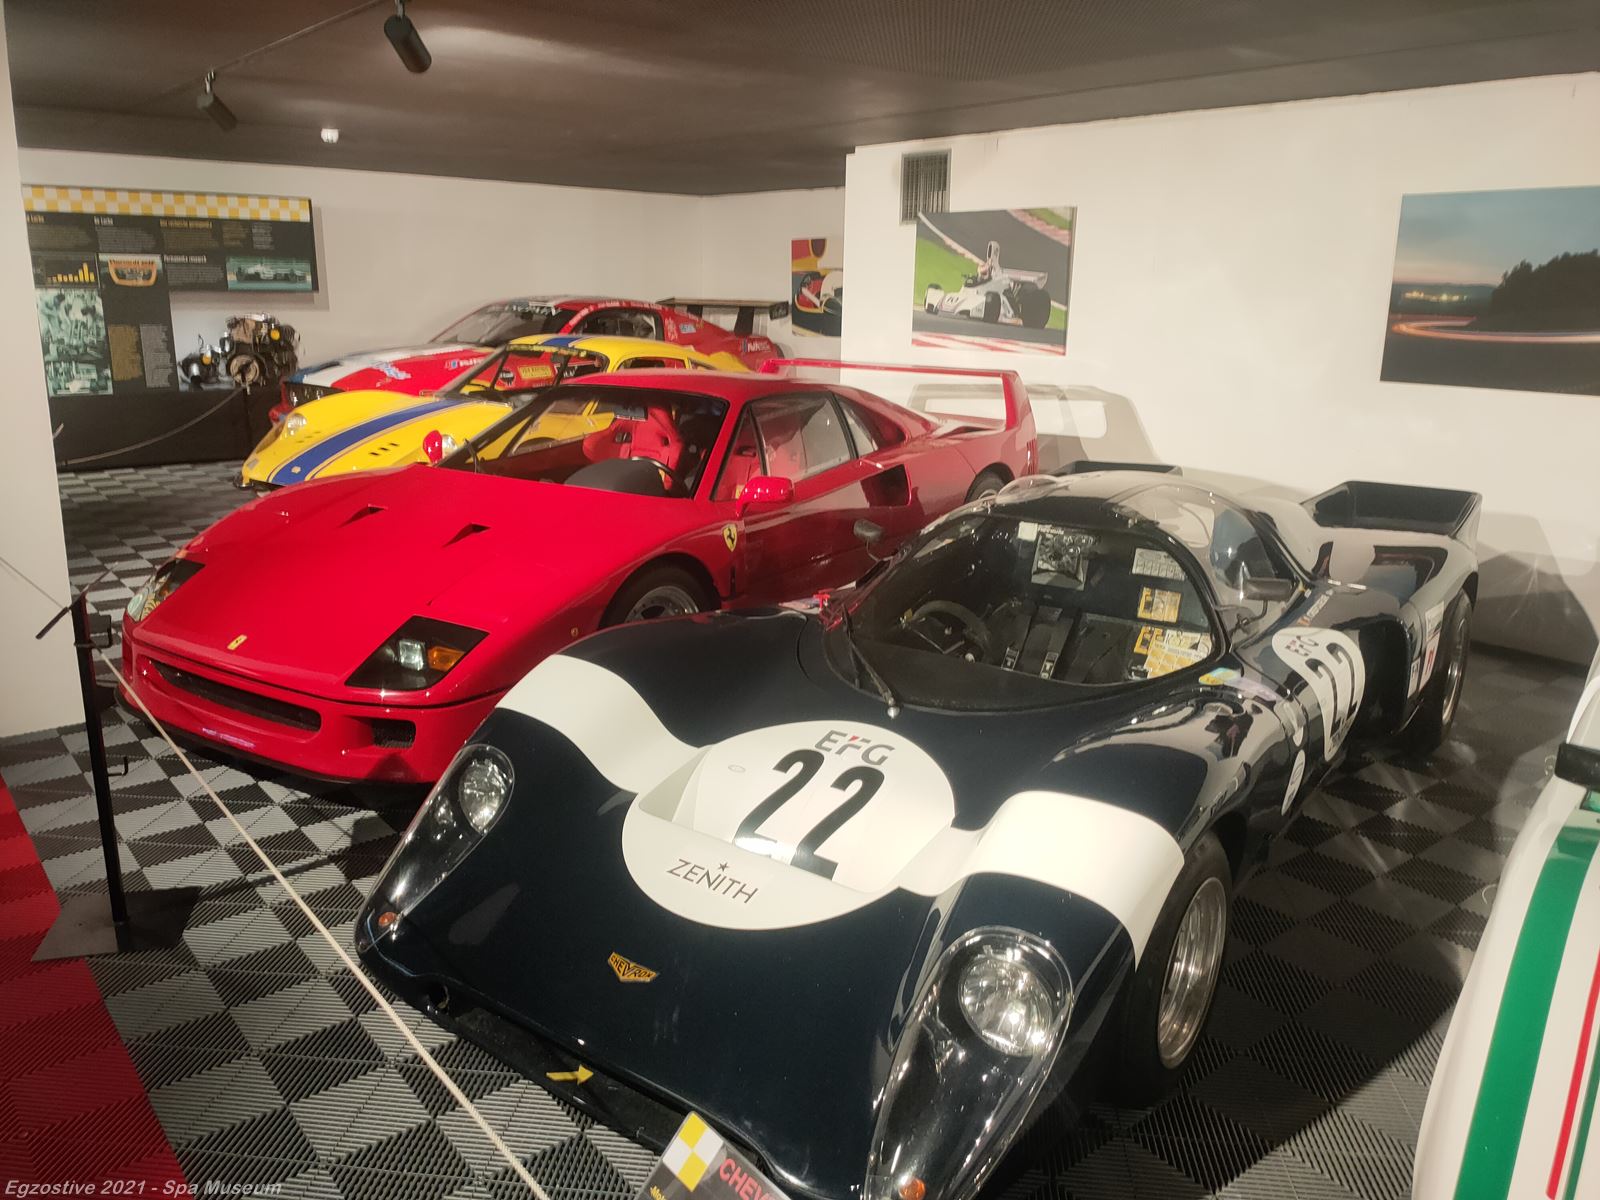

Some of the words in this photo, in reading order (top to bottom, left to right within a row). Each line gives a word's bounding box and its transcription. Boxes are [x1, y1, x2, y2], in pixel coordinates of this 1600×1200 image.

[1304, 642, 1358, 739] 22
[814, 729, 896, 766] EFG
[732, 748, 885, 881] 22
[665, 858, 759, 905] ZENITH
[610, 954, 654, 979] CHEVRON
[719, 1158, 773, 1200] CHEV
